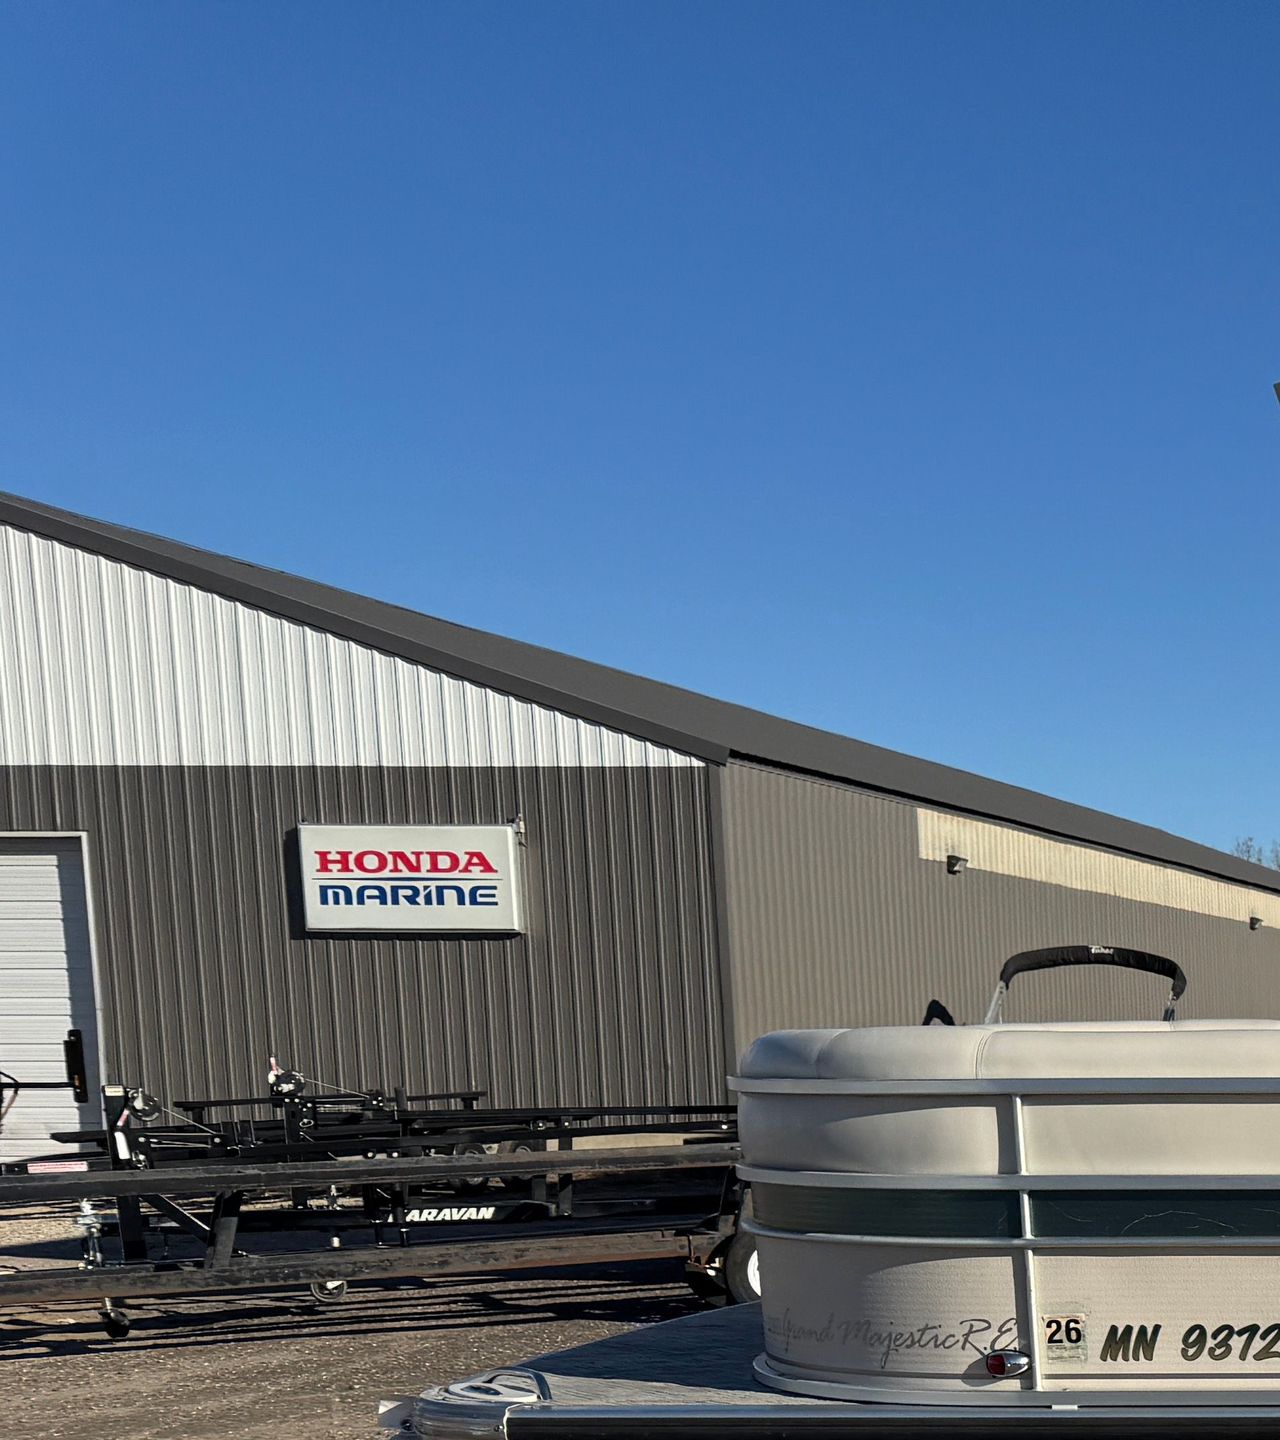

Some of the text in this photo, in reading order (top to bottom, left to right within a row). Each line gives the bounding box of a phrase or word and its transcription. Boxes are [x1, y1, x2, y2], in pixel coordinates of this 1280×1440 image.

[314, 850, 498, 874] HONDA
[319, 885, 498, 906] MARINE
[387, 1207, 495, 1223] ARAVAN
[1046, 1319, 1081, 1345] 26
[1100, 1324, 1161, 1361] MN
